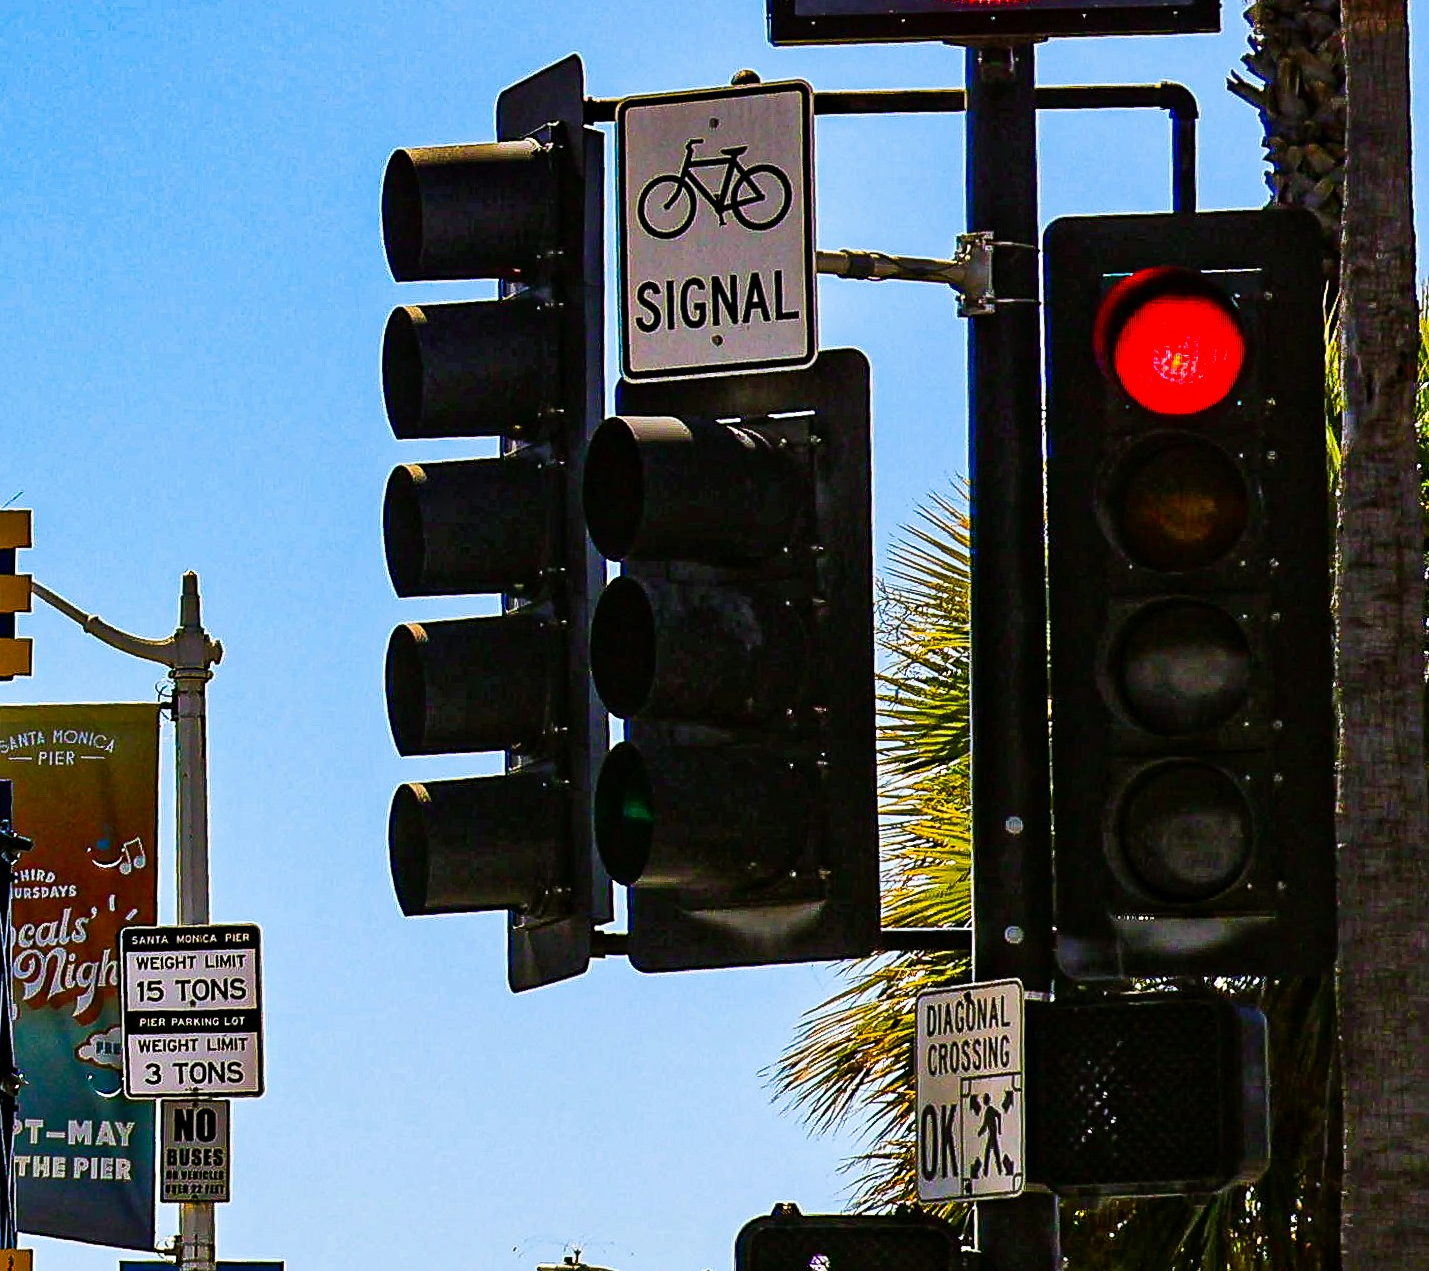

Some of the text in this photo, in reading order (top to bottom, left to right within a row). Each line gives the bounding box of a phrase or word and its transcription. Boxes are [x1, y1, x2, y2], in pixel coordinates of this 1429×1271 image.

[635, 270, 800, 333] SIGNAL
[53, 730, 115, 753] MONICA
[38, 751, 76, 765] PIER
[14, 868, 56, 883] HIRD
[132, 933, 250, 945] SANTA MONICA PIER
[136, 954, 246, 970] WEIGHT LIMIT
[136, 977, 247, 1002] 15 TONS
[139, 1016, 245, 1027] PIER PARKING LOT
[926, 996, 1011, 1038] DIAGONAL
[138, 1037, 248, 1053] WEIGHT LIMIT
[927, 1037, 1011, 1076] CROSSING
[144, 1061, 244, 1085] 3 TONS
[174, 1108, 217, 1142] NO
[920, 1102, 959, 1182] OK
[15, 1155, 132, 1181] THE PIER
[167, 1148, 224, 1166] BUSES
